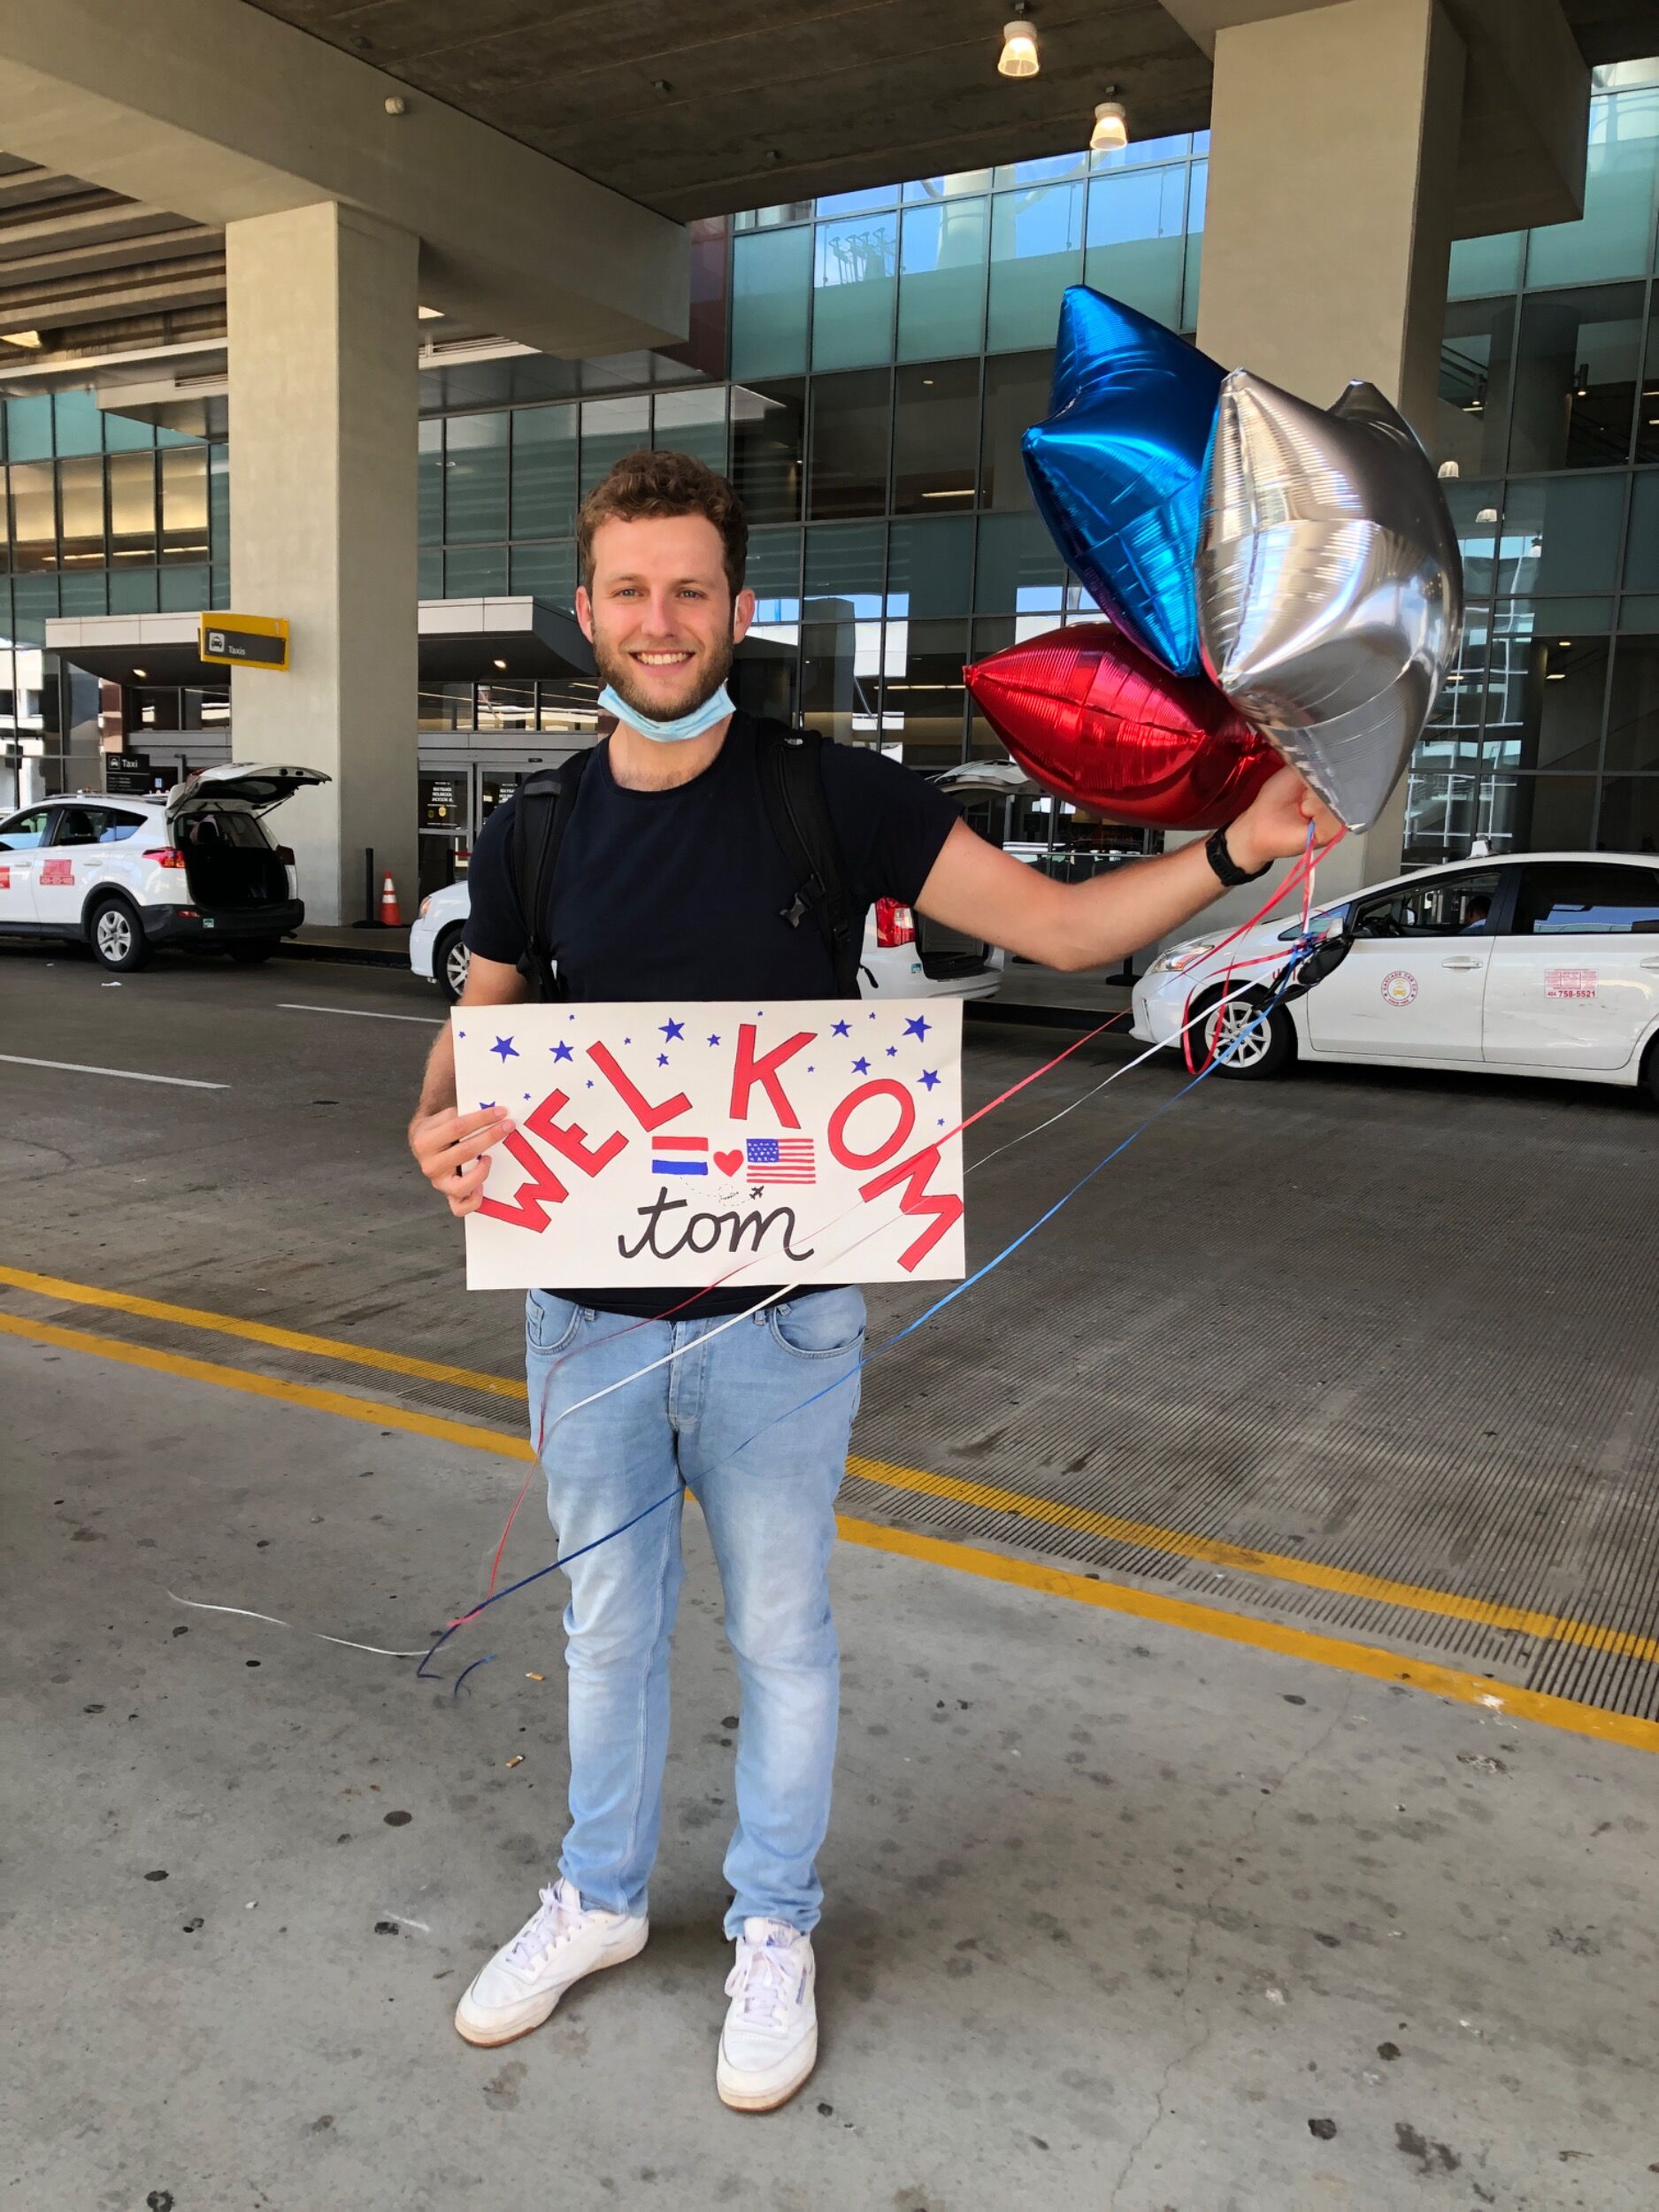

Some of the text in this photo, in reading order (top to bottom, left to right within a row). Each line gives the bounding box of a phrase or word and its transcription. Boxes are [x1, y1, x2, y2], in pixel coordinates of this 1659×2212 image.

[227, 646, 246, 656] Taxis
[122, 759, 138, 768] Taxi
[476, 1023, 964, 1272] WELKOM
[618, 1187, 814, 1261] tom
